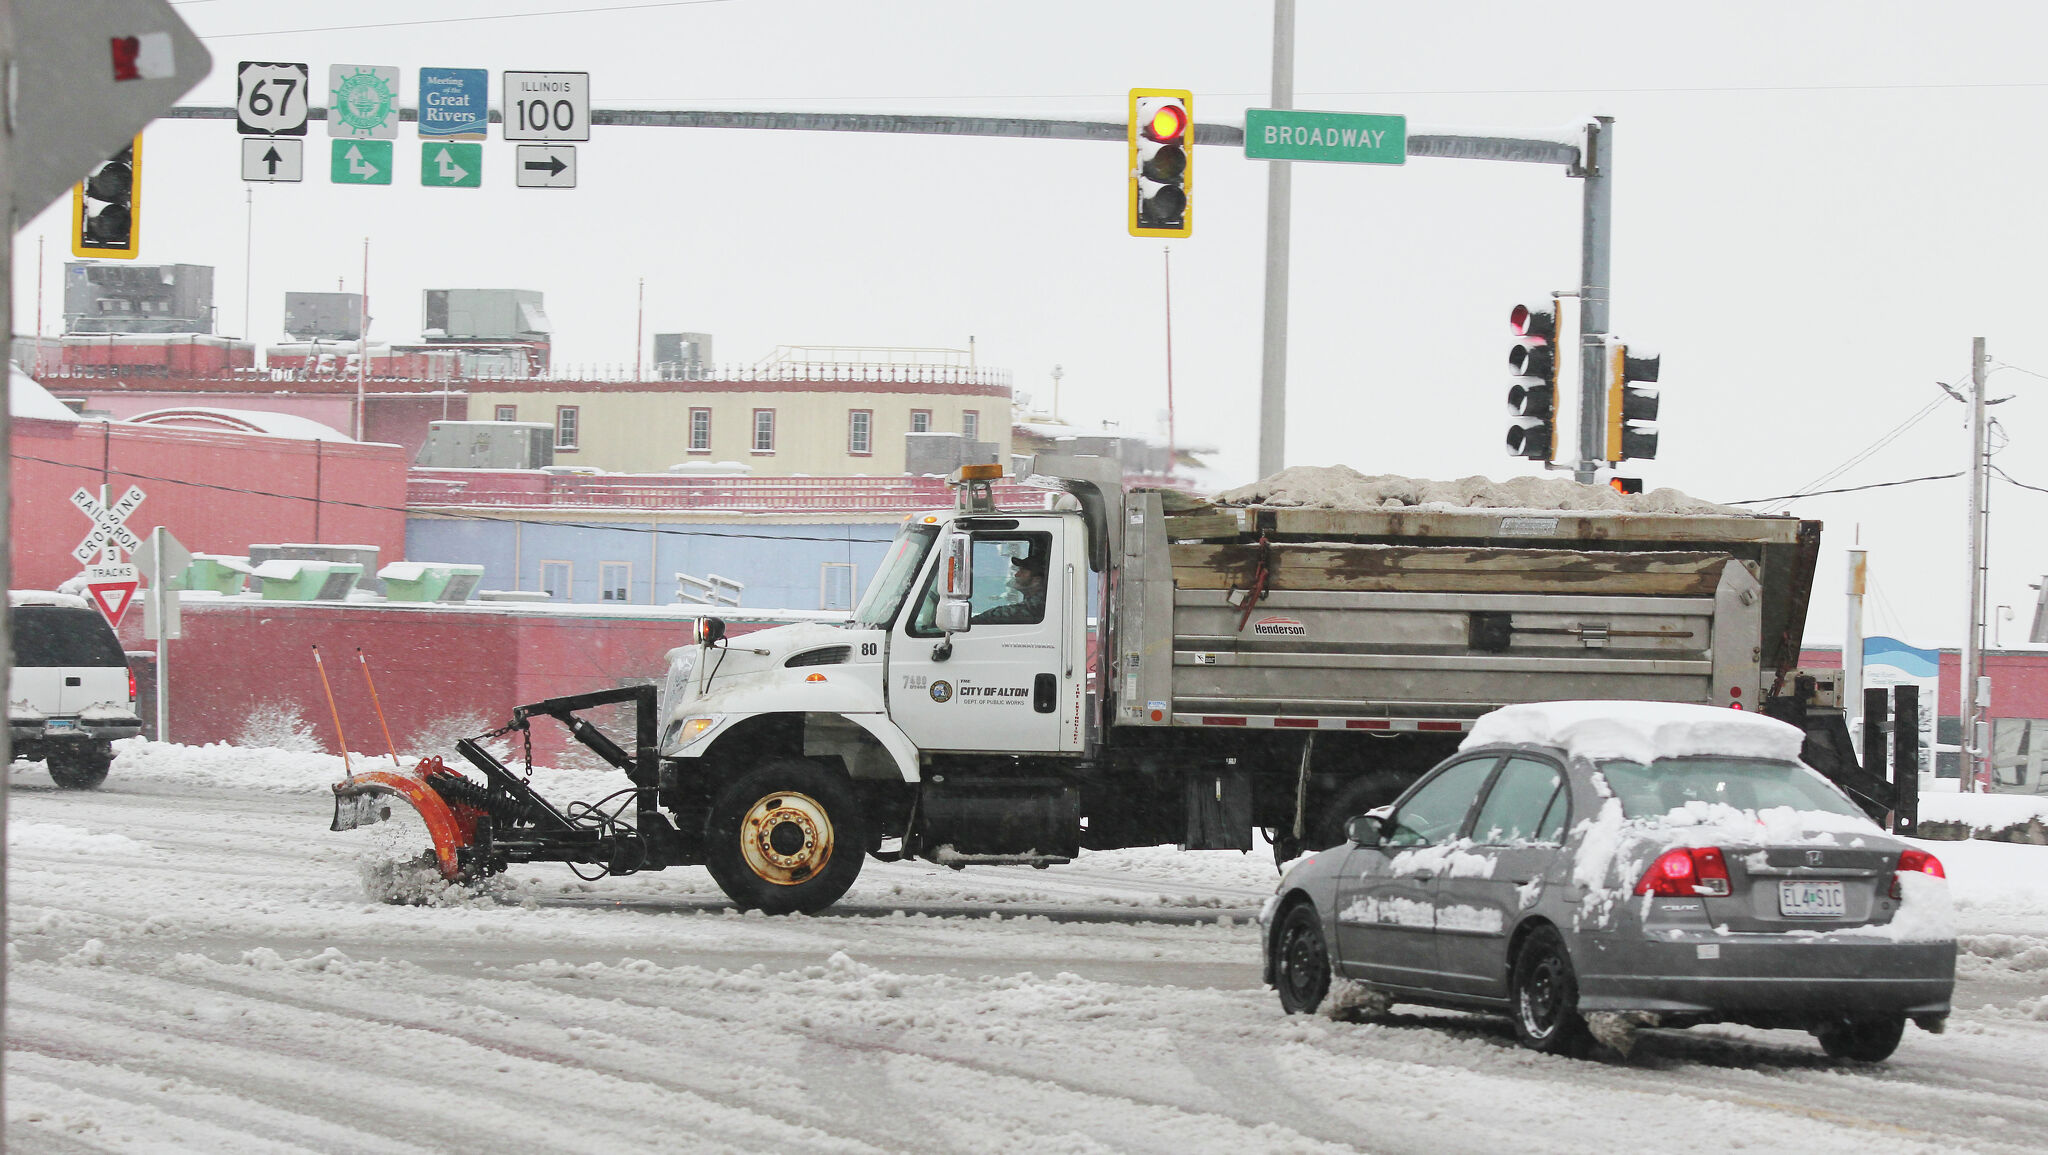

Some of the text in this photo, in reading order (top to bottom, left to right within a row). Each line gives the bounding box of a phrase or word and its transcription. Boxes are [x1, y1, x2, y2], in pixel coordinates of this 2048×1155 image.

[426, 76, 464, 87] Meeting
[521, 81, 571, 93] ILLINOIS
[250, 79, 297, 116] 67
[426, 91, 471, 106] Great
[426, 107, 476, 122] Rivers
[517, 99, 575, 131] 100
[1264, 125, 1386, 149] BROADWAY
[74, 491, 138, 553] RAILROA
[78, 489, 141, 559] CROSSING
[107, 549, 116, 561] 3
[92, 567, 132, 578] TRACKS
[1254, 624, 1305, 635] Henderson
[861, 643, 877, 656] 80
[960, 687, 1030, 697] CITY OF ALTON
[1784, 888, 1809, 907] EL4
